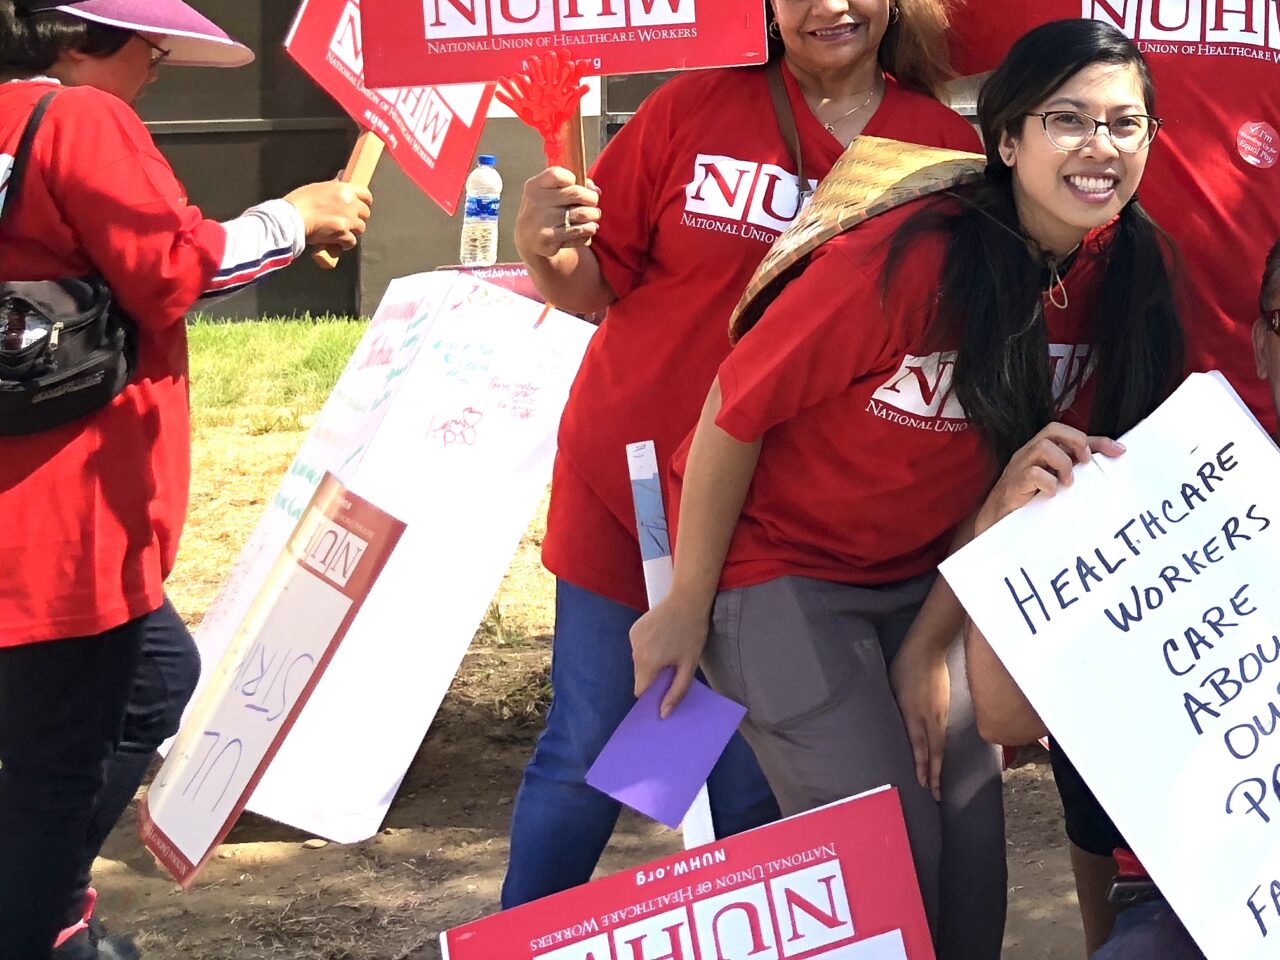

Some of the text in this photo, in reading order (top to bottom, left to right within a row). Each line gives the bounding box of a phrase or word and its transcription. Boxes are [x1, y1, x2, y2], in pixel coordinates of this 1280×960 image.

[427, 27, 698, 54] NATIONAL UNION OF HEALTHCARE WORKERS
[1136, 42, 1178, 54] UNION
[1181, 45, 1197, 55] OF
[1198, 43, 1271, 61] HEALTHCARE
[680, 213, 739, 235] NATIONAL
[865, 400, 968, 433] NATIONAL UNIO
[1004, 441, 1240, 635] HEALTHCARE
[1103, 503, 1271, 632] WORKERS
[1162, 584, 1257, 676] CARE
[636, 848, 727, 887] NUHW.org
[768, 842, 838, 874] NATIONAL
[716, 865, 765, 890] UNION
[601, 885, 694, 928] HEALTHCARE
[529, 917, 600, 952] WORKERS
